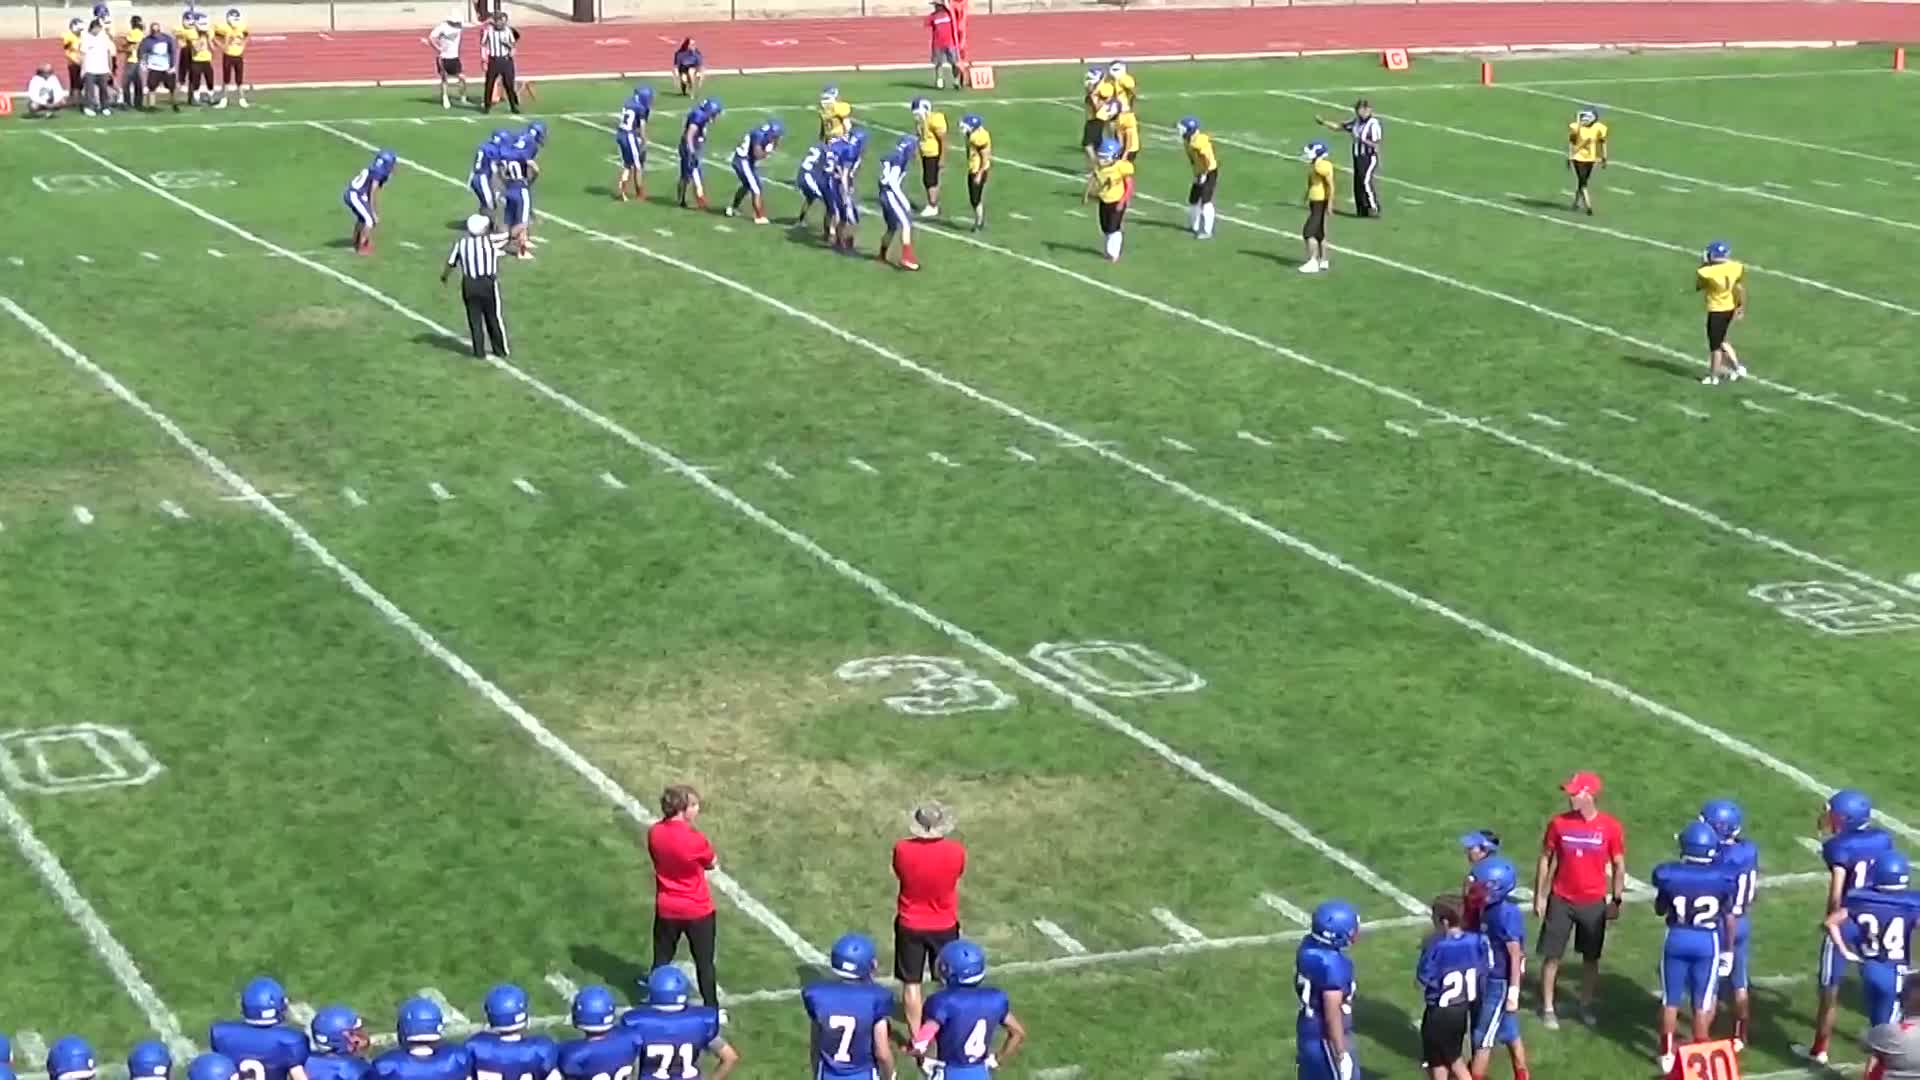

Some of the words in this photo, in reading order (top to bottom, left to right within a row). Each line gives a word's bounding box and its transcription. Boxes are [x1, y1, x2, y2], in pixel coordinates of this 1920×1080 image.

[974, 71, 991, 85] 10
[1672, 896, 1719, 929] 12
[1732, 870, 1756, 915] 11
[1856, 913, 1905, 960] 34
[1439, 967, 1478, 1007] 21
[829, 1015, 856, 1062] 7
[964, 1018, 987, 1063] 4
[646, 1043, 699, 1079] 71
[1686, 1048, 1731, 1080] 30
